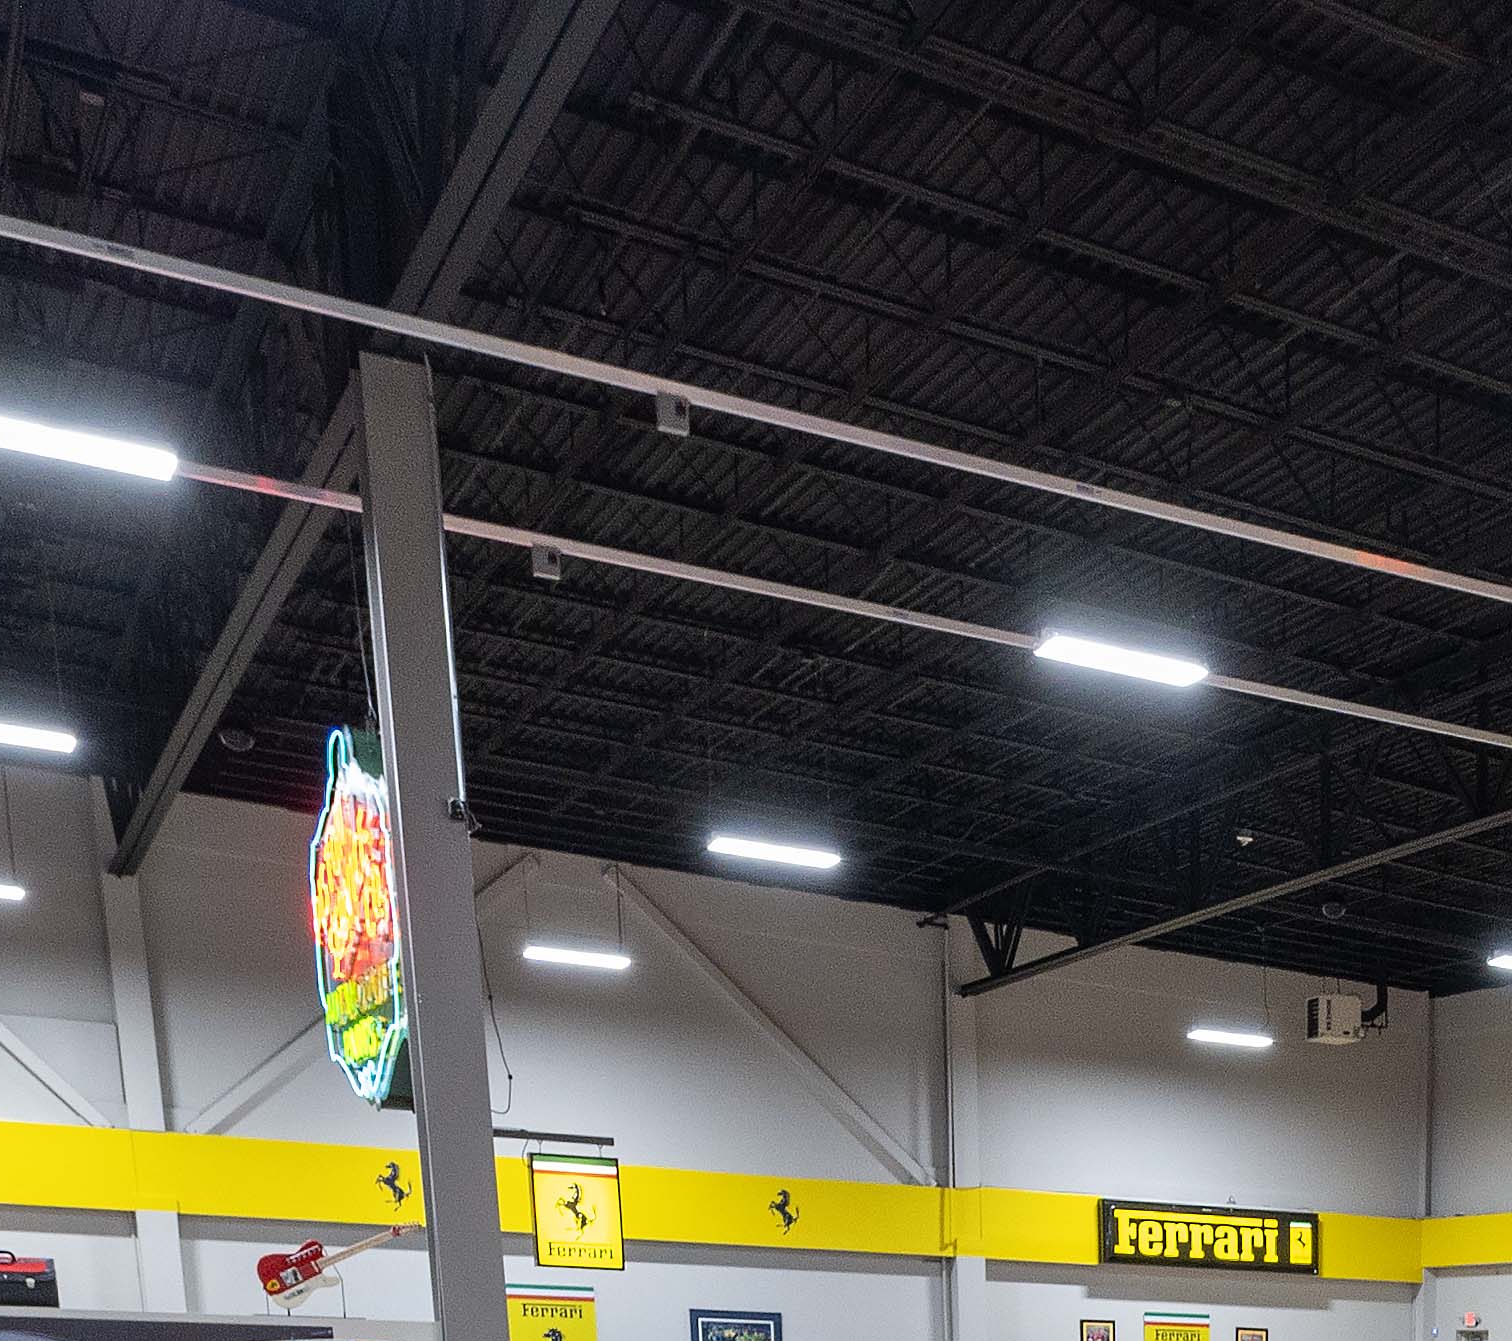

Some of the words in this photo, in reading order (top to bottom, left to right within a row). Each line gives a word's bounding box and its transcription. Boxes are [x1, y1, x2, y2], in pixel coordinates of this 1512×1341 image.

[1113, 1209, 1279, 1263] Ferrari
[548, 1241, 614, 1260] Ferrari
[522, 1303, 583, 1319] Ferrari
[1155, 1329, 1200, 1341] Ferrari
